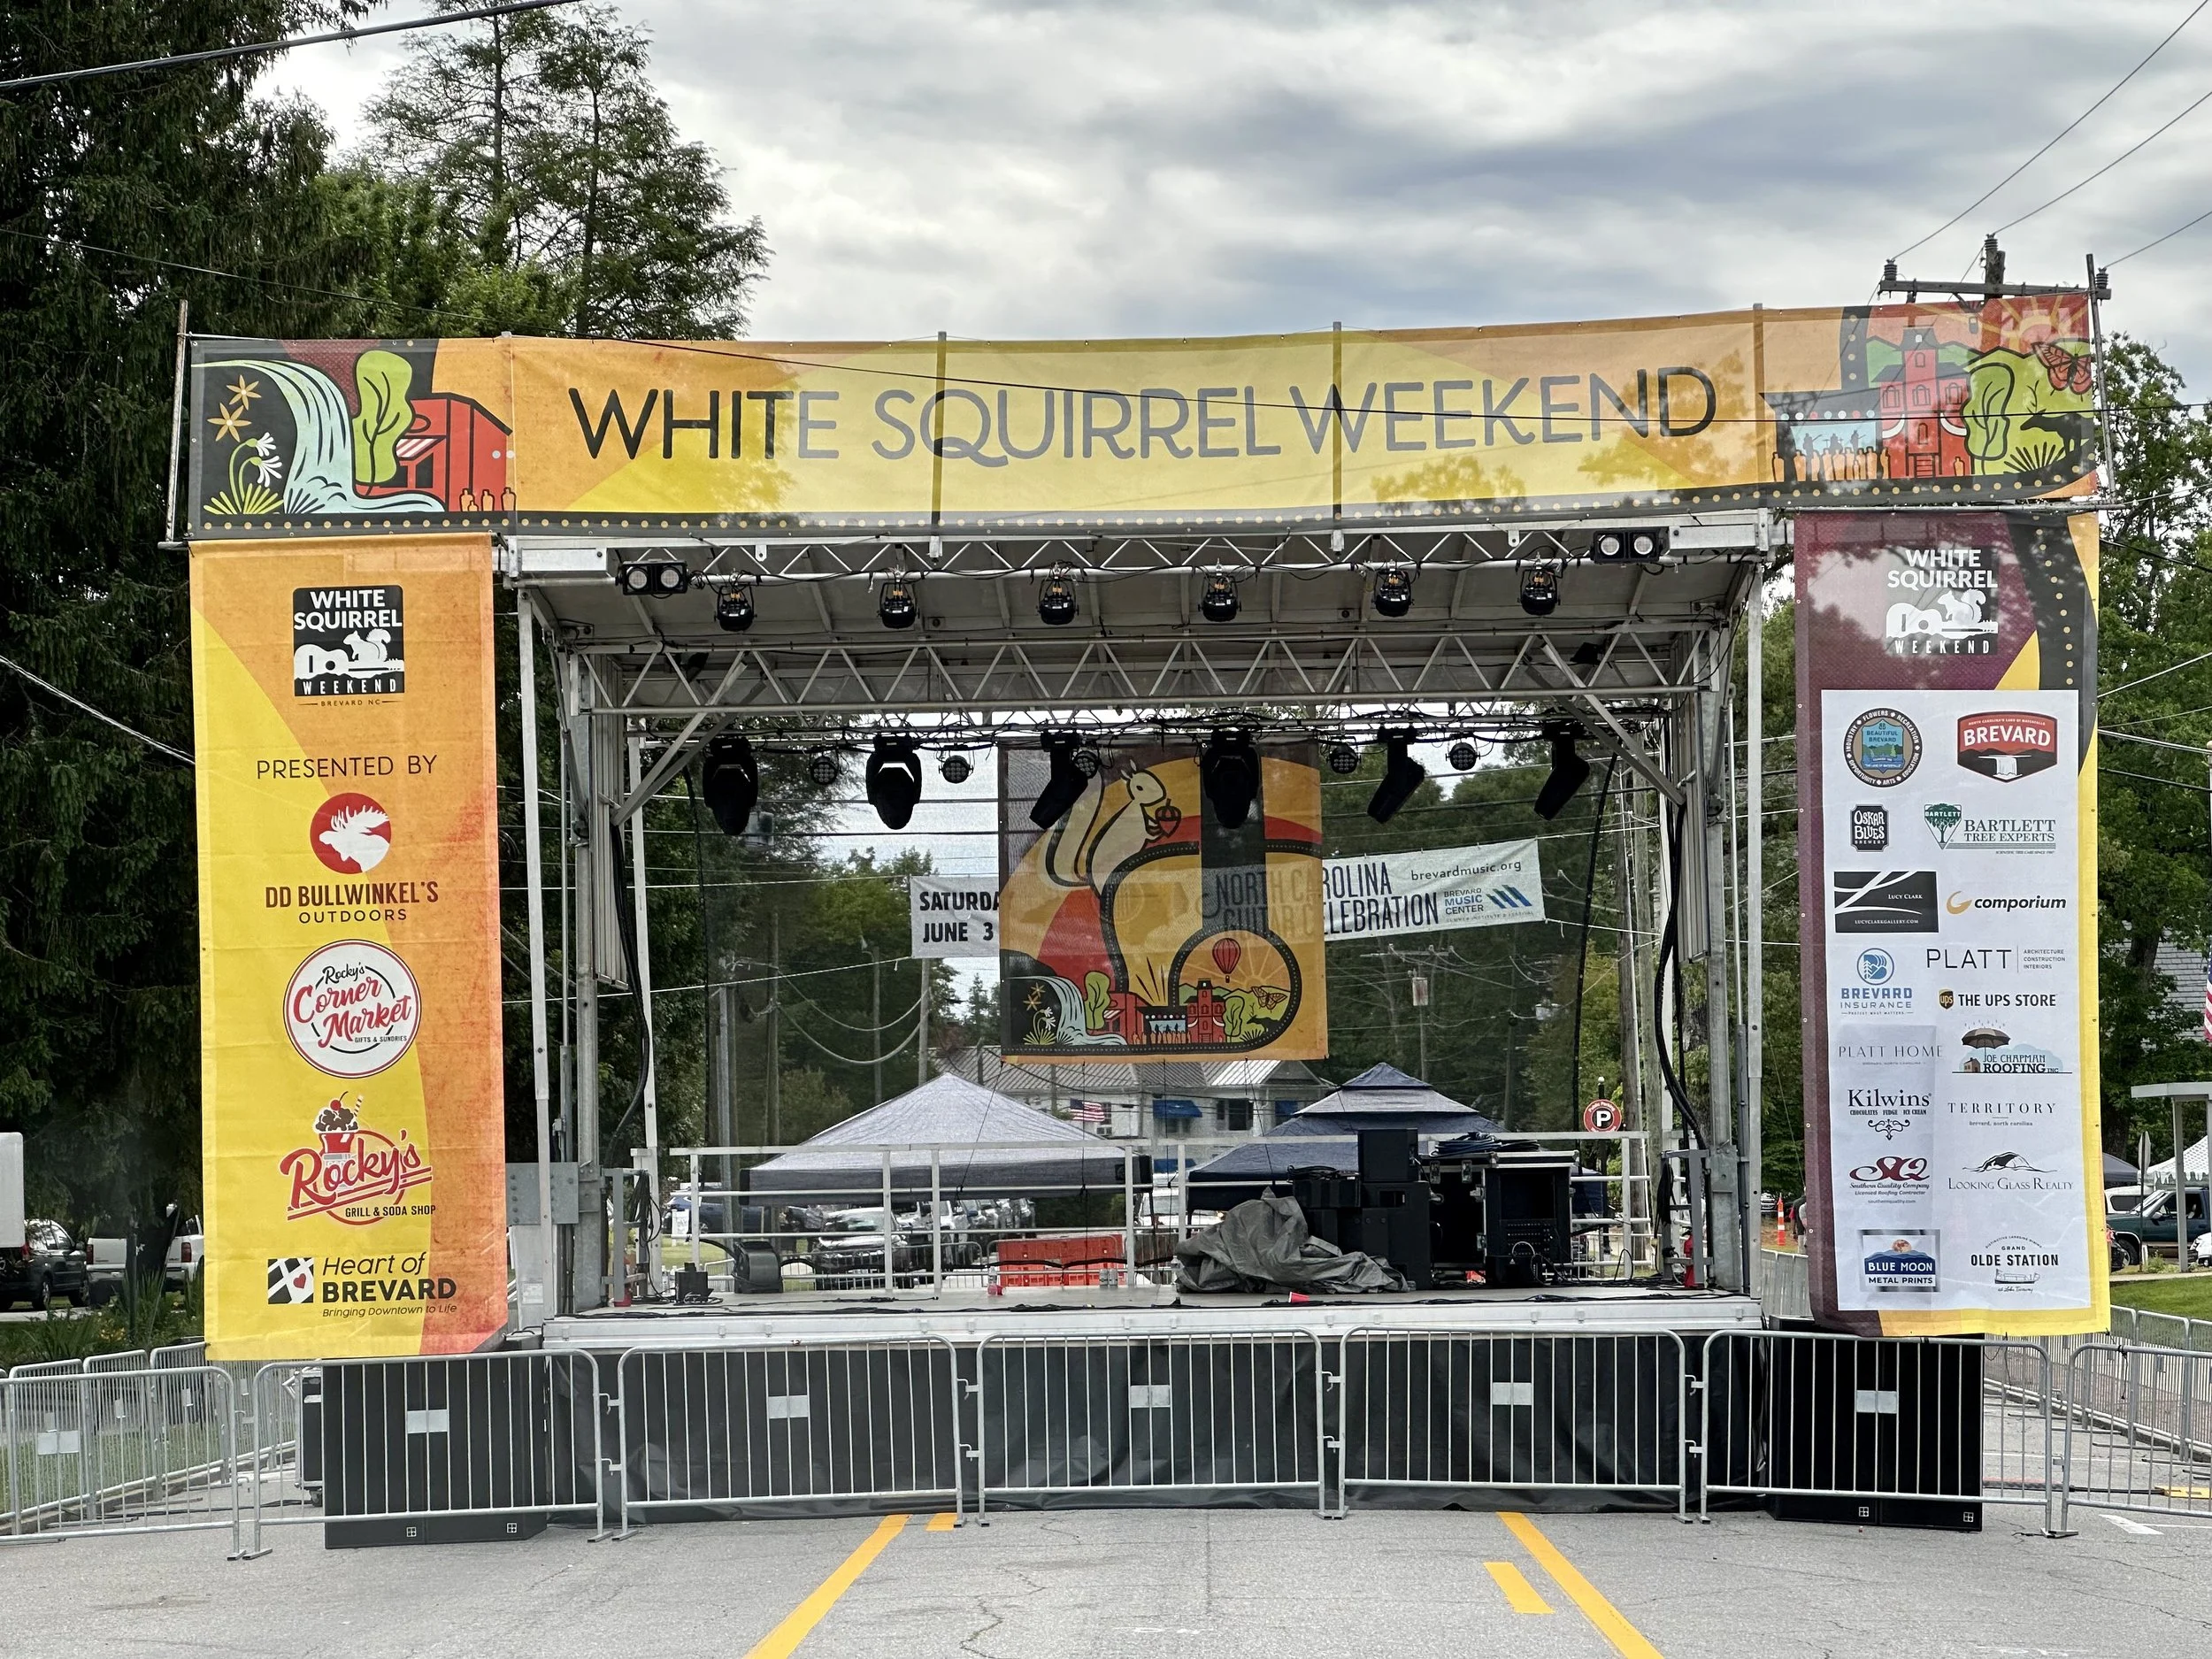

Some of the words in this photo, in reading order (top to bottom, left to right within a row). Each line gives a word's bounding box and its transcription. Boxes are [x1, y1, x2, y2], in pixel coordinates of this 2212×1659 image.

[568, 388, 839, 460] WHITE
[872, 387, 1281, 468] SQUIRREL
[1289, 366, 1717, 453] WEEKEND
[1906, 549, 1981, 567] WHITE
[1887, 570, 1998, 591] SQUIRREL
[310, 589, 386, 609] WHITE
[293, 609, 403, 631] SQUIRREL
[1894, 640, 1990, 654] WEEKEND
[302, 679, 397, 695] WEEKEND
[1862, 710, 1889, 721] FLOWERS
[1896, 714, 1919, 744] RECREATION
[1963, 726, 2051, 747] BREVARD
[1846, 725, 1858, 752] INDUSTRY
[257, 756, 394, 780] PRESENTED
[408, 755, 437, 774] BY
[1848, 759, 1877, 784] OPPORTUNITY
[1901, 752, 1919, 778] EDUCATION
[1854, 810, 1885, 826] OSKAR
[1963, 819, 2056, 832] BARTLETT
[1855, 826, 1885, 840] BLUES
[1963, 833, 1996, 841] TREE
[1999, 833, 2055, 841] EXPERTS
[1410, 861, 1522, 881] brevardmusic.org
[265, 887, 291, 908] DD
[298, 881, 439, 907] BULLWINKEL'S
[1444, 887, 1482, 897] BREVARD
[919, 891, 1000, 911] SATURDA
[1444, 895, 1483, 907] MUSIC
[1445, 904, 1484, 915] CENTER
[1974, 895, 2067, 912] comporium
[298, 909, 407, 924] OUTDOORS
[923, 922, 968, 942] JUNE
[982, 922, 994, 941] 3
[1926, 949, 2011, 969] PLATT
[322, 962, 365, 984] Rocky's
[293, 976, 382, 1023] Corner
[1841, 987, 1912, 999] BREVARD
[1940, 995, 1953, 1007] ups
[1958, 995, 1980, 1006] THE
[1985, 995, 2010, 1006] UPS
[2015, 995, 2056, 1006] STORE
[318, 995, 411, 1048] Market
[1839, 1046, 1886, 1057] PLATT
[1894, 1045, 1943, 1057] HOME
[1983, 1054, 1997, 1063] JOE
[2000, 1054, 2046, 1063] CHAPMAN
[1983, 1063, 2046, 1073] ROOFING
[1847, 1088, 1930, 1107] Kilwins
[1947, 1102, 2055, 1114] TERRITORY
[1596, 1110, 1611, 1127] P
[280, 1129, 421, 1209] Rocky's
[1849, 1156, 1930, 1181] SQ
[1948, 1178, 1994, 1190] LOOKING
[1997, 1177, 2031, 1190] GLASS
[2033, 1177, 2074, 1190] REALTY
[345, 1208, 370, 1217] GRILL
[373, 1207, 380, 1217] &
[382, 1206, 407, 1217] SODA
[411, 1205, 436, 1215] SHOP
[322, 1254, 395, 1276] Heart
[401, 1251, 426, 1275] of
[1868, 1262, 1896, 1271] BLUE
[1901, 1263, 1932, 1271] MOON
[1970, 1254, 2001, 1266] OLDE
[2007, 1254, 2059, 1266] STATION
[322, 1278, 457, 1302] BREVARD
[322, 1307, 365, 1317] Bringing
[368, 1305, 423, 1316] Downtown
[438, 1303, 457, 1313] Life
